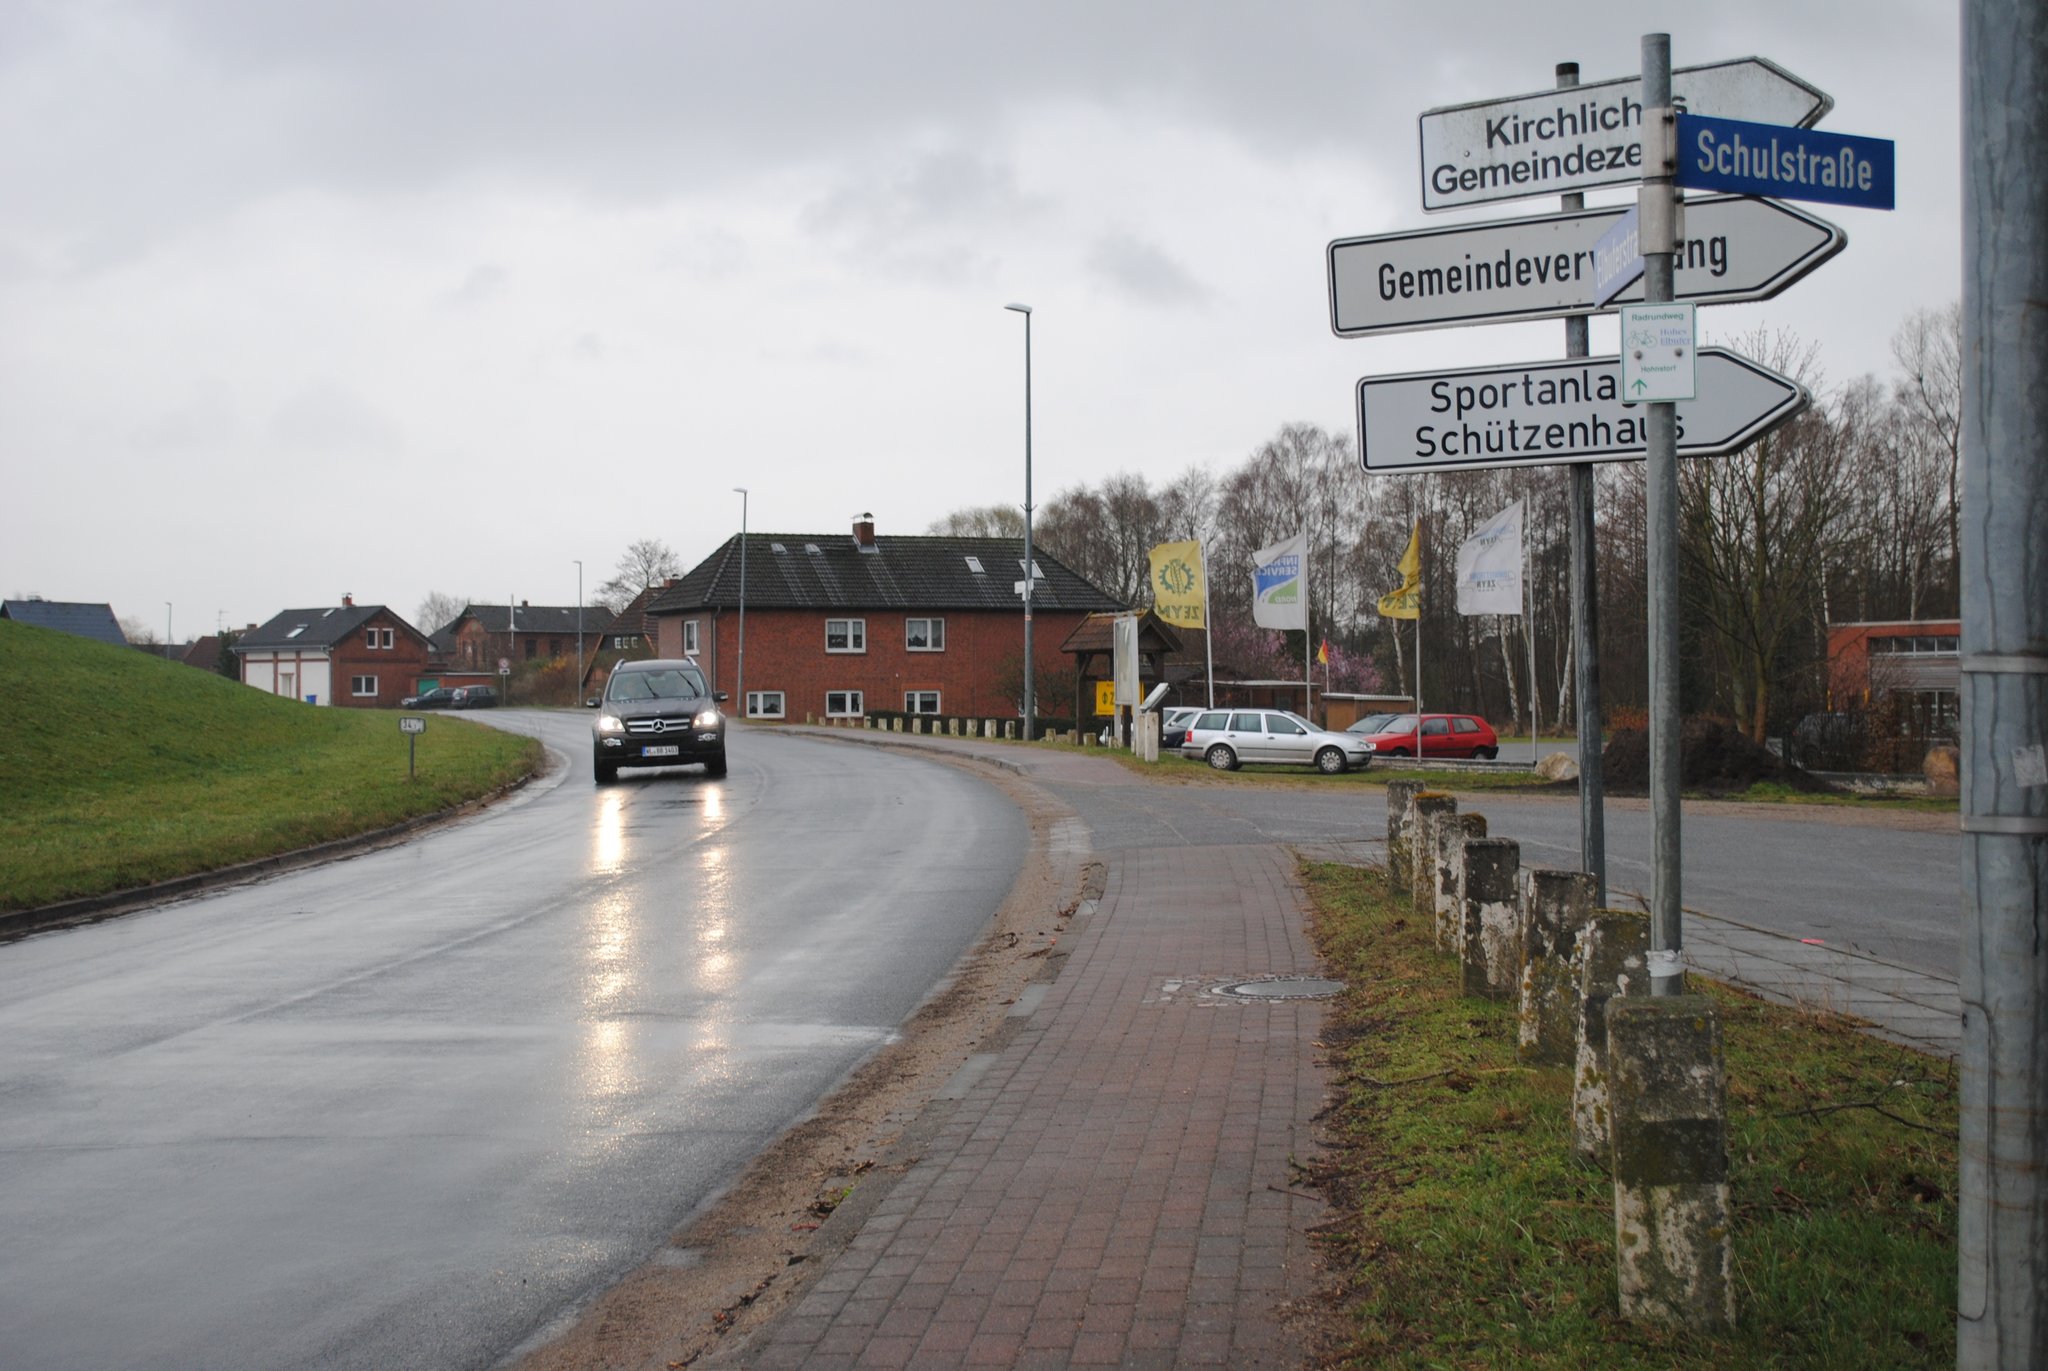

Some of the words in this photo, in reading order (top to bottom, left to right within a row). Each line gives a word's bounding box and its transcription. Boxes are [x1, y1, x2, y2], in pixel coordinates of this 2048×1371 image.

[1486, 96, 1688, 149] Kirchlichs
[1431, 143, 1642, 194] Gemeindeze
[1697, 129, 1872, 191] Schulstraße
[1378, 236, 1728, 301] Gemeindeverng
[1597, 229, 1638, 289] Elbuferstra
[1631, 313, 1684, 321] Radrundweg
[1660, 337, 1691, 345] Elbufer
[1430, 369, 1638, 420] Sportanla
